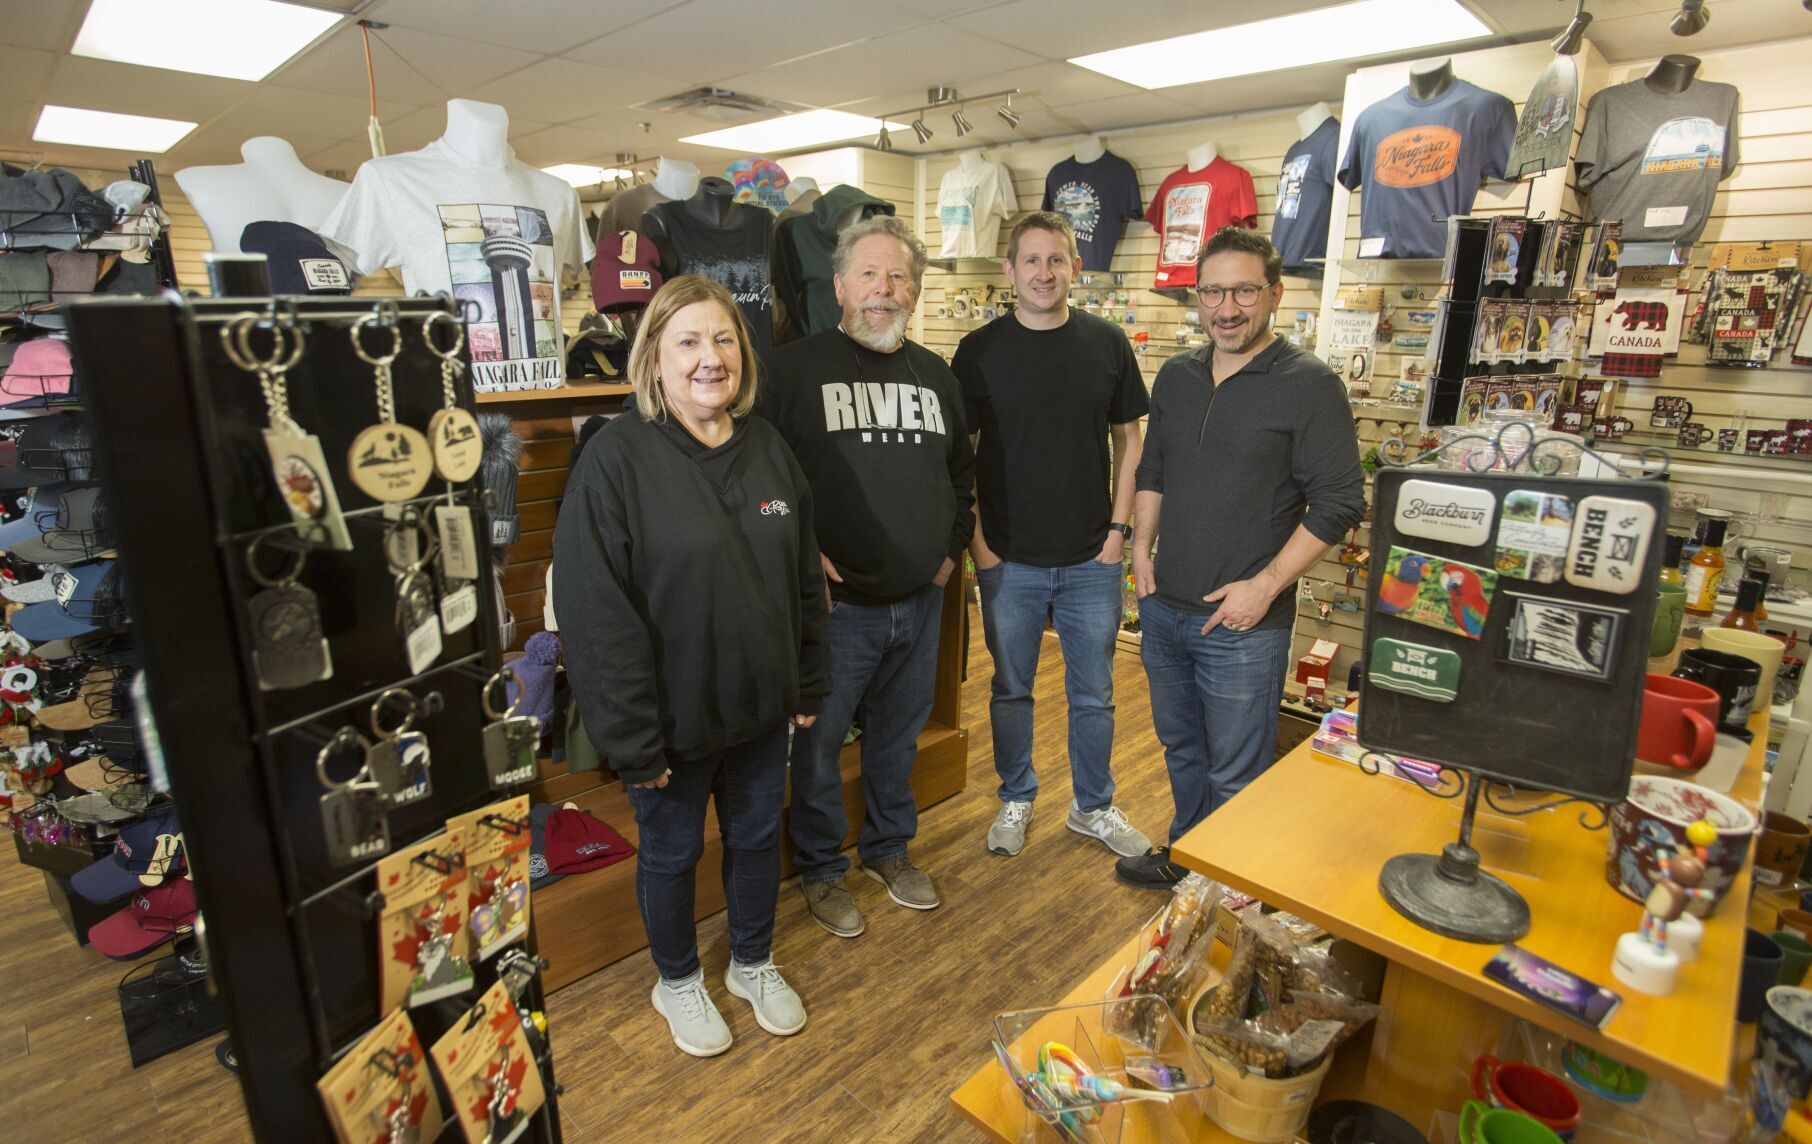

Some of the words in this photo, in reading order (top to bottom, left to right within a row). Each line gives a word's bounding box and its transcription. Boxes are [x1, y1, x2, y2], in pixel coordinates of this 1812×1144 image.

[1381, 140, 1450, 168] Niagara
[1408, 154, 1450, 179] Falls
[1334, 319, 1372, 327] NIAGARA
[1721, 309, 1756, 317] CANADA
[1332, 333, 1372, 345] LAKE
[1609, 335, 1662, 348] CANADA
[1719, 330, 1754, 338] CANADA
[821, 381, 946, 435] RIVER
[862, 432, 921, 444] WEAR
[1402, 498, 1487, 526] Blackburn
[1574, 508, 1608, 578] BENCH
[1392, 660, 1437, 681] BENCH
[495, 765, 533, 785] MOOSE
[394, 782, 427, 803] WOLF
[351, 839, 385, 858] BEAR
